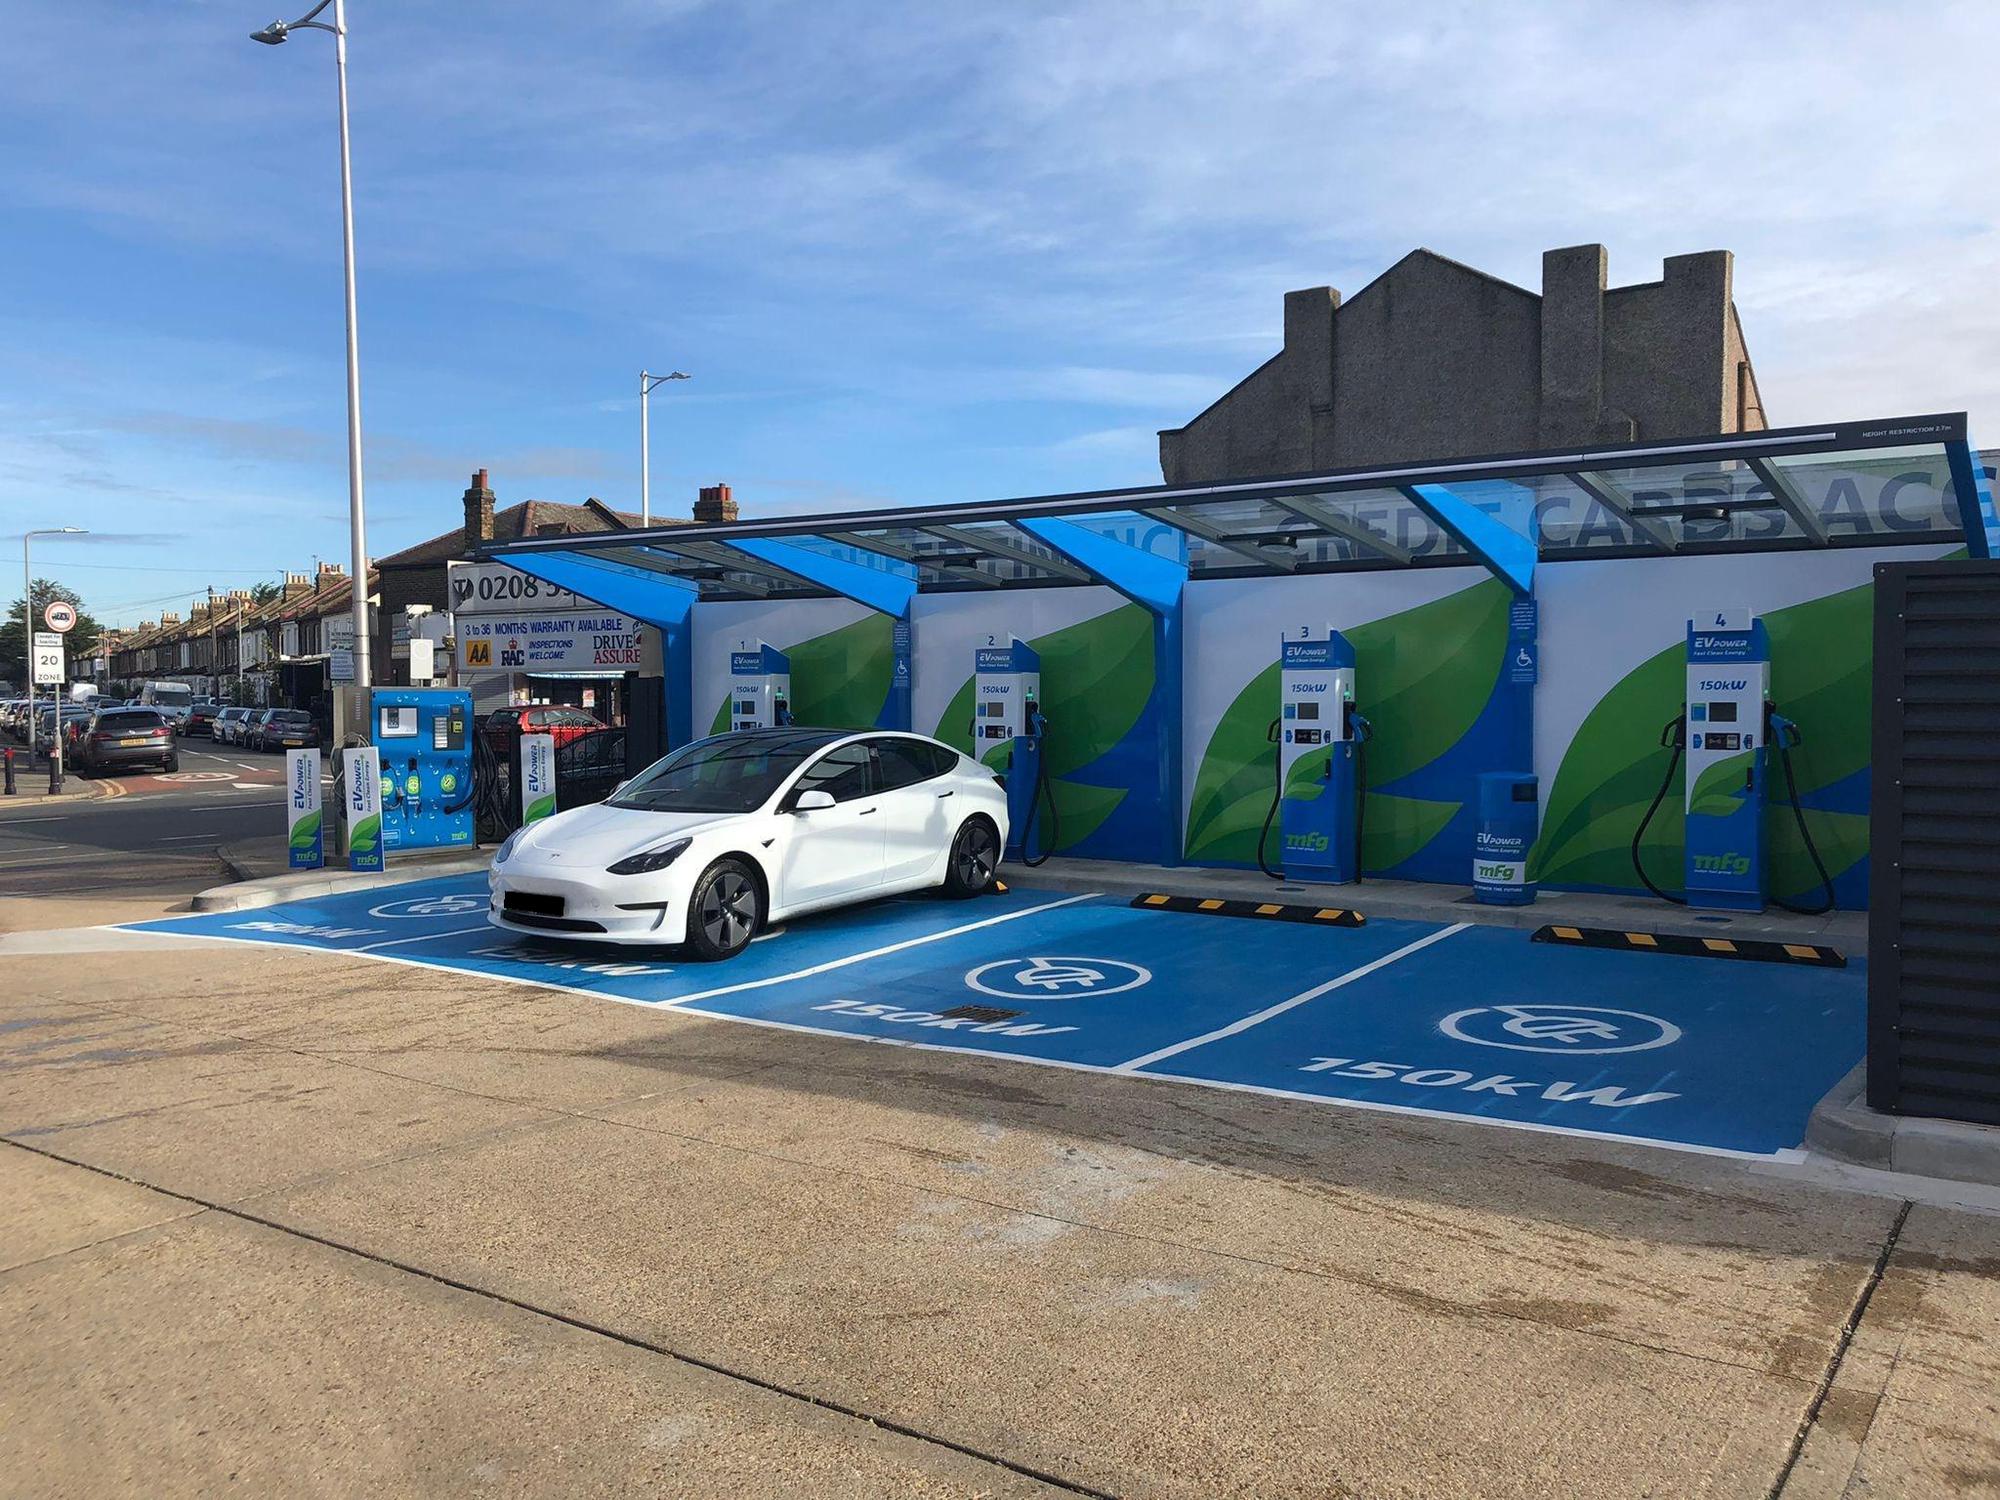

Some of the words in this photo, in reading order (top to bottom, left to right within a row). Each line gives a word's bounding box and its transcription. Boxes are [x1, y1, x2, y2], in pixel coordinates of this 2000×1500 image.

[1862, 430, 1887, 438] HEIGHT
[1889, 427, 1934, 436] RESTRICTION
[479, 575, 539, 600] 0208
[1715, 613, 1727, 627] 4
[465, 624, 471, 636] 3
[472, 625, 480, 635] to
[481, 624, 491, 635] 36
[495, 622, 528, 635] MONTHS
[530, 620, 575, 634] WARRANTY
[577, 619, 623, 631] AVAILABLE
[1301, 626, 1309, 638] 3
[529, 639, 574, 649] INSPECTIONS
[593, 634, 634, 650] DRIVE
[740, 640, 745, 650] 1
[988, 635, 995, 646] 2
[469, 643, 489, 664] AA
[501, 650, 525, 666] RAC
[529, 650, 565, 660] WELCOME
[40, 655, 58, 666] 20
[38, 673, 61, 681] ZONE
[982, 685, 1010, 694] 150kW
[1291, 683, 1328, 693] 150kW
[1699, 680, 1747, 691] 150kW
[1285, 832, 1329, 852] mfg
[296, 850, 318, 861] mfg
[356, 854, 379, 865] mfg
[1693, 852, 1751, 875] mfg
[1479, 864, 1516, 881] mfg
[810, 999, 1082, 1036] 150kW
[1298, 1057, 1682, 1107] 150kW
